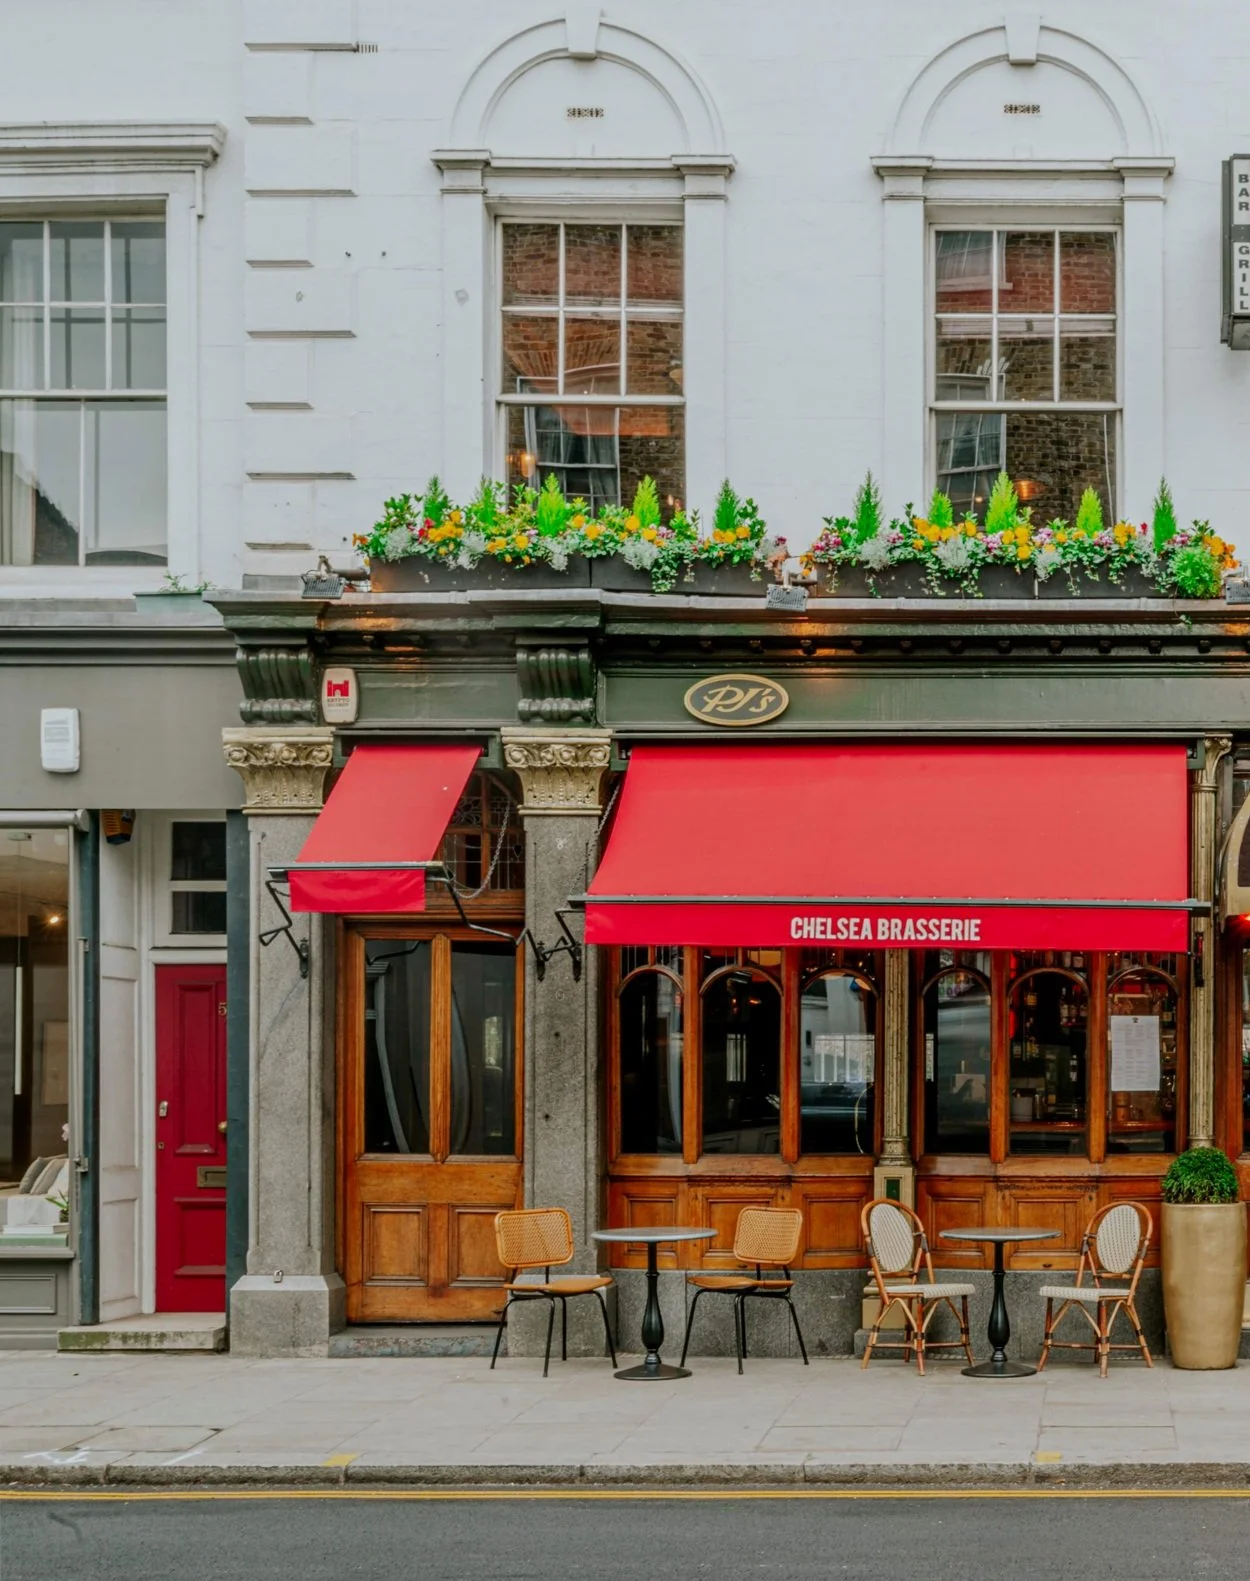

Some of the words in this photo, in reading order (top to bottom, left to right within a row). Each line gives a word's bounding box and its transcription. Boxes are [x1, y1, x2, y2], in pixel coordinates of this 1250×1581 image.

[1238, 174, 1250, 211] BAR
[1238, 246, 1250, 310] GRILL
[700, 685, 776, 713] PJ's
[790, 917, 873, 940] CHELSEA
[877, 918, 981, 941] BRASSERIE
